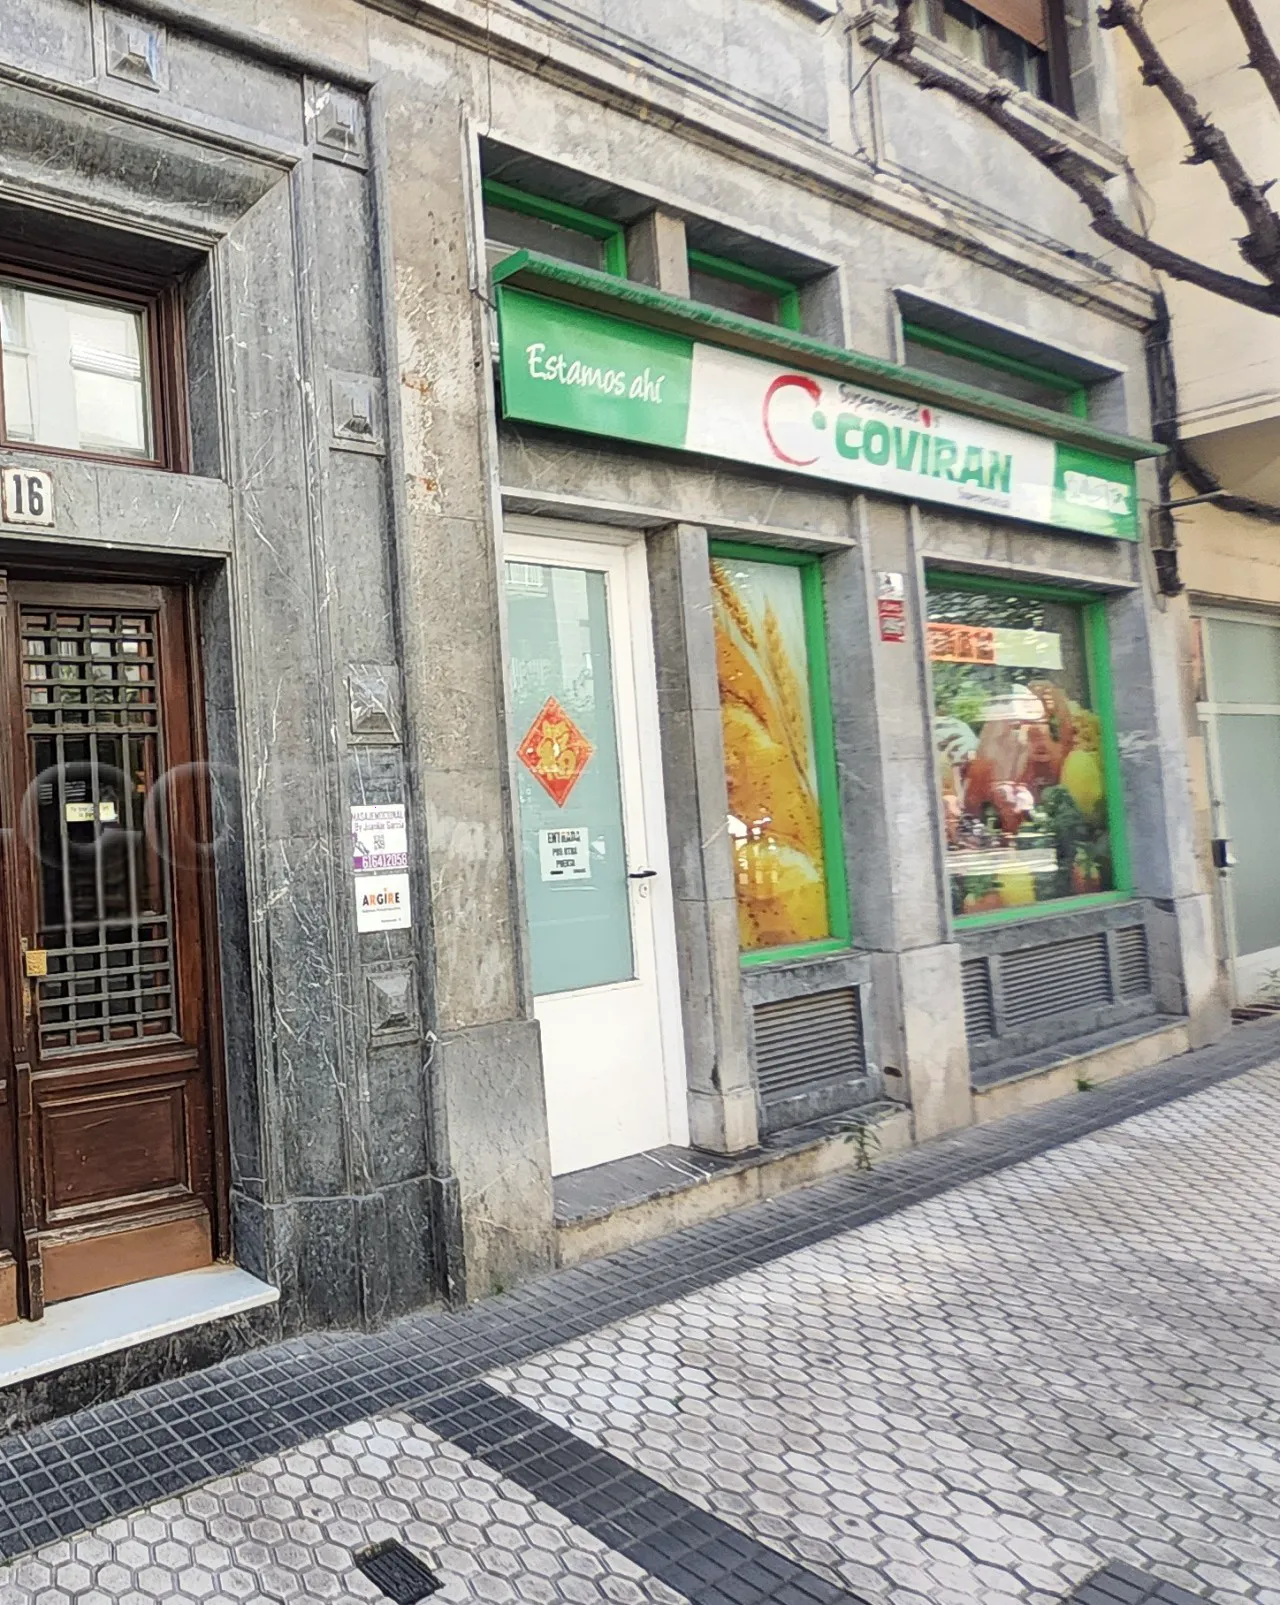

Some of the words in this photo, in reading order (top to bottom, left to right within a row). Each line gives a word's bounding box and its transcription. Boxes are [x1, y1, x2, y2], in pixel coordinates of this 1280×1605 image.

[526, 343, 626, 395] Estamos
[629, 367, 666, 404] ahí
[13, 474, 45, 516] 16
